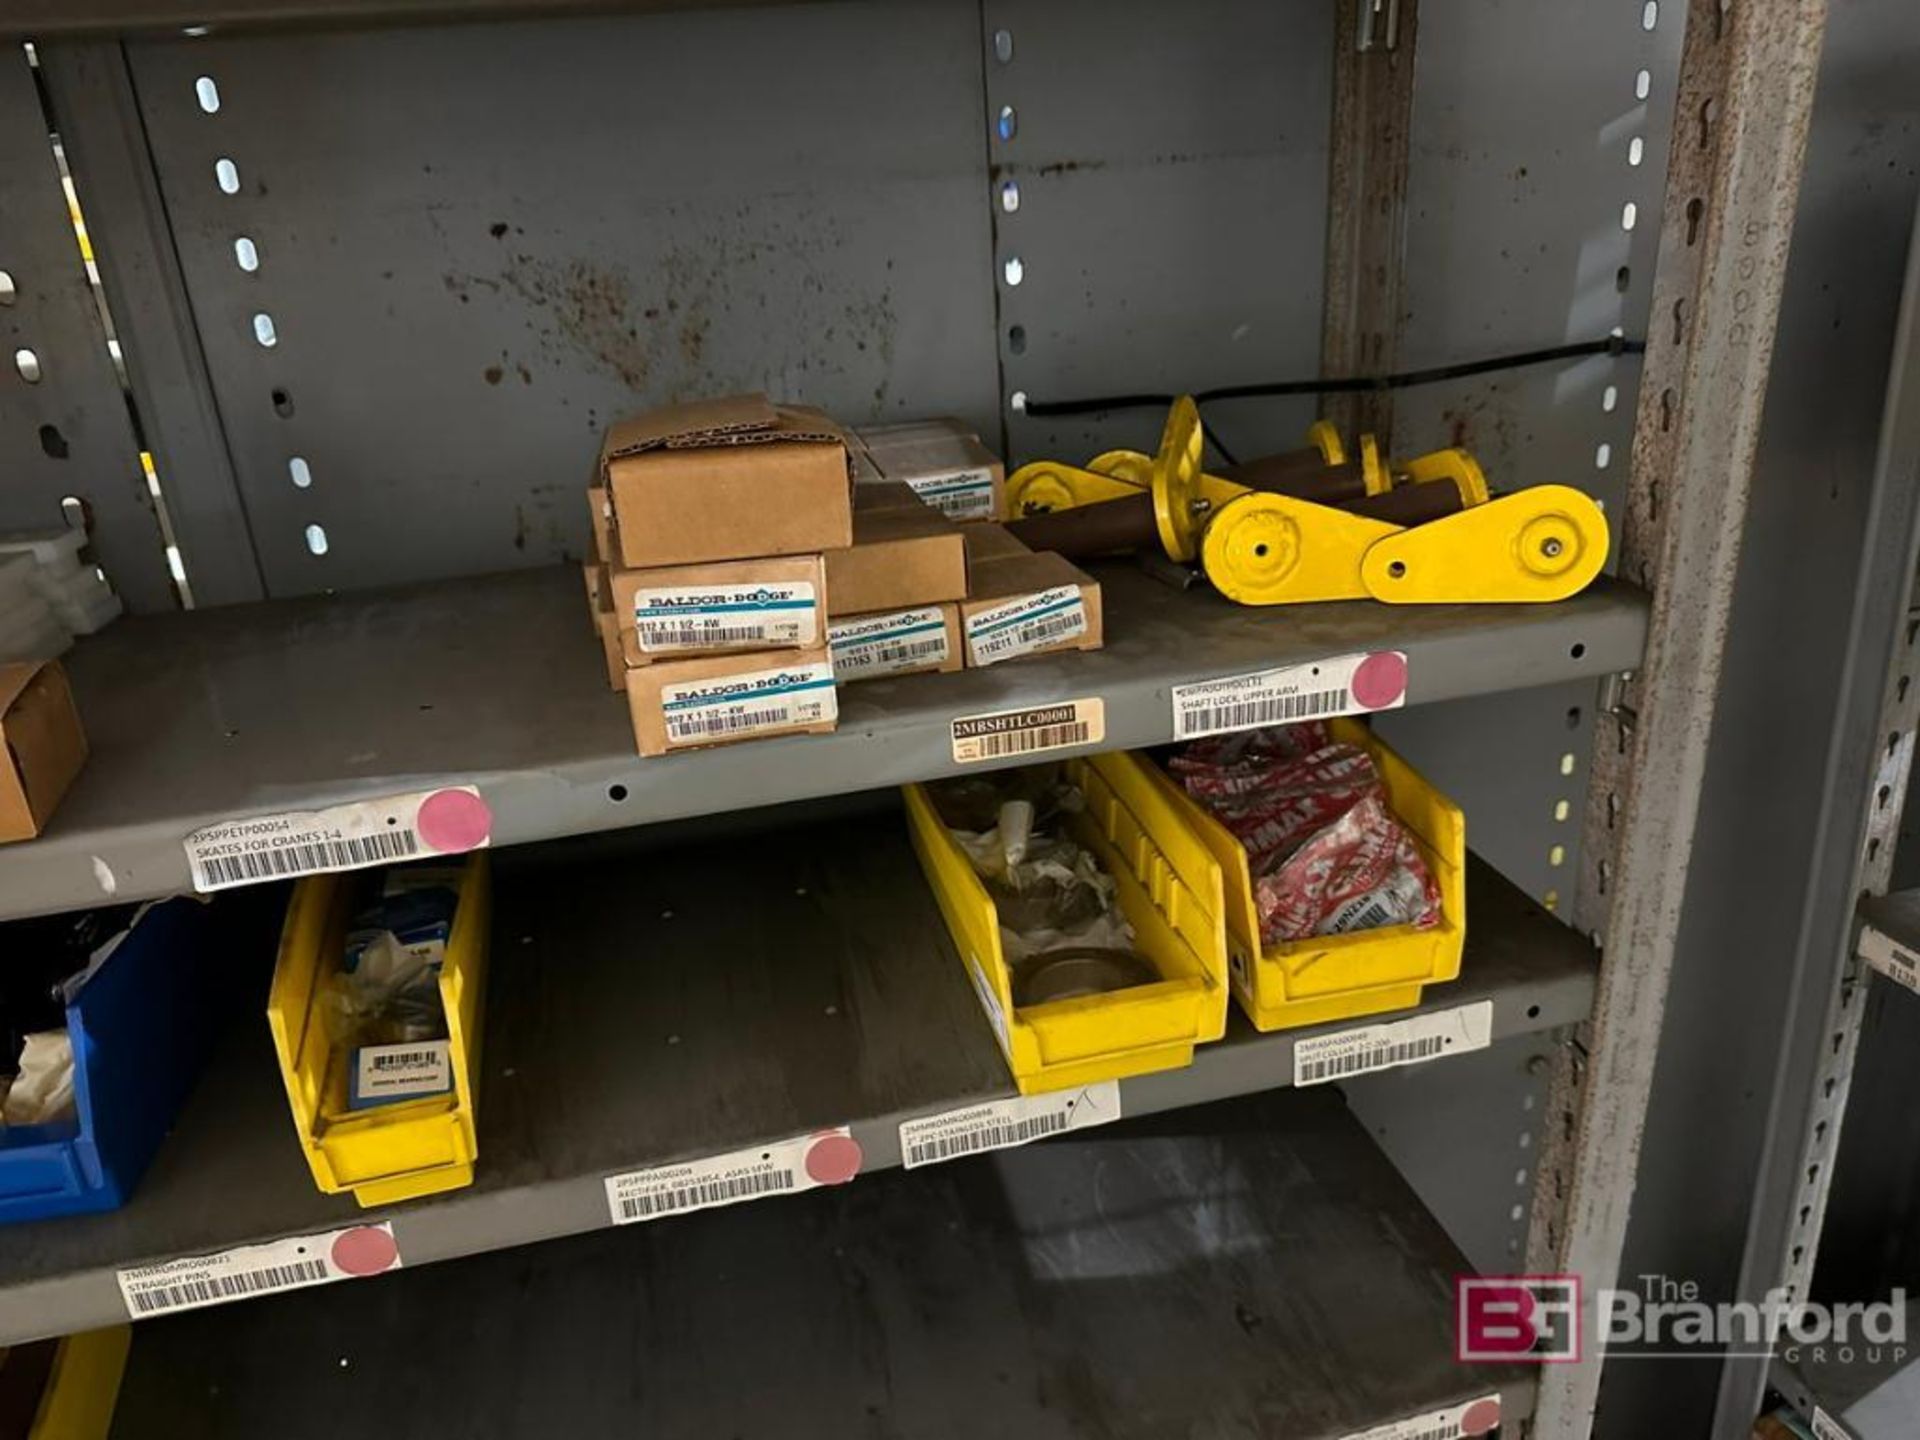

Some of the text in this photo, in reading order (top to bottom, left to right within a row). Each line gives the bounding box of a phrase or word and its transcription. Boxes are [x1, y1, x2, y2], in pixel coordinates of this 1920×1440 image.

[1181, 698, 1211, 709] SHAFT
[1244, 689, 1274, 701] UPPER
[1275, 685, 1300, 696] ARM
[196, 842, 243, 858] SKATES
[245, 838, 271, 853] FOR
[272, 831, 321, 848] CRANES
[127, 1270, 211, 1291] STRAIGHT PINS
